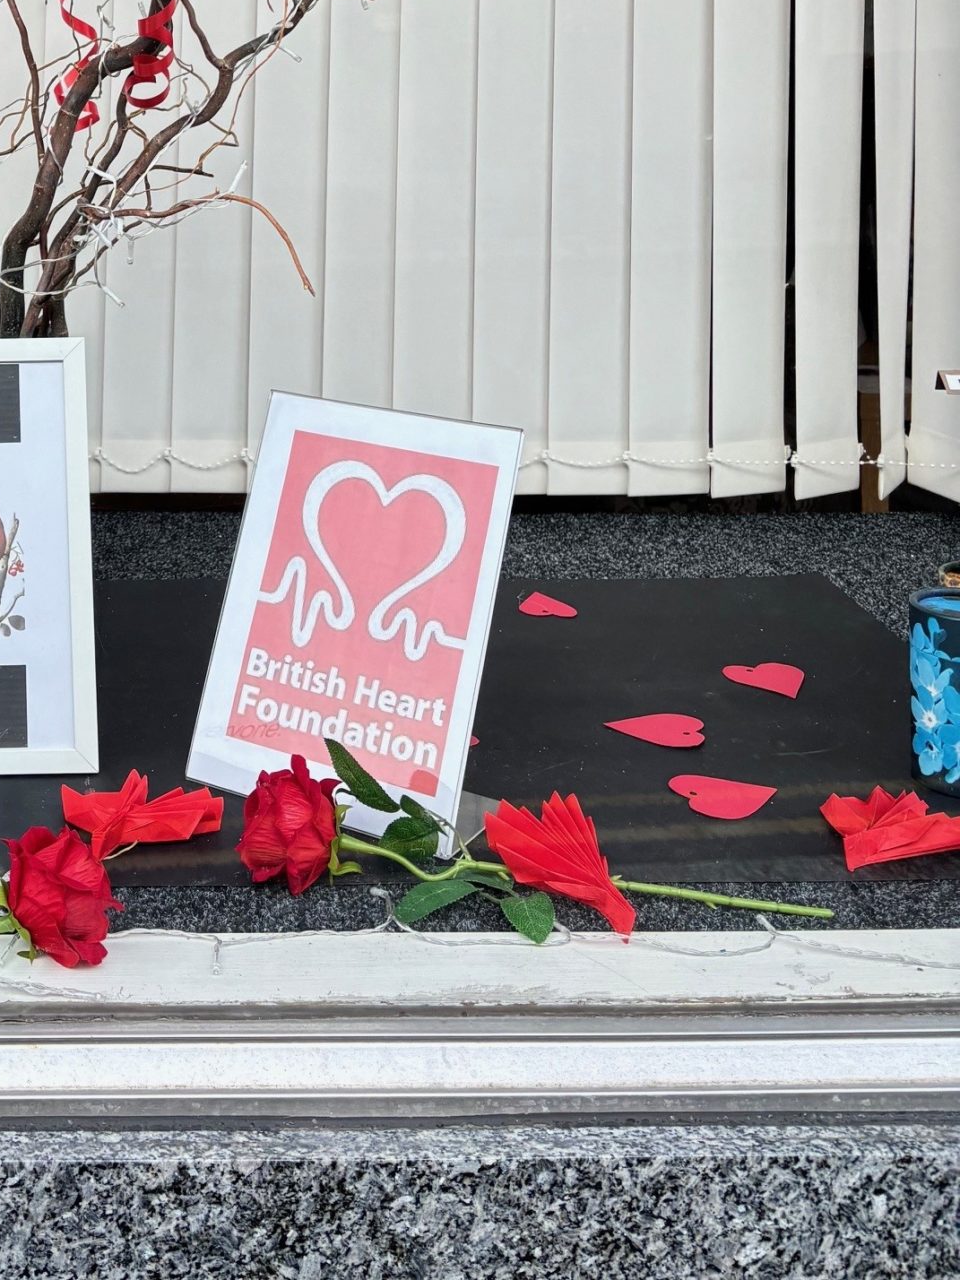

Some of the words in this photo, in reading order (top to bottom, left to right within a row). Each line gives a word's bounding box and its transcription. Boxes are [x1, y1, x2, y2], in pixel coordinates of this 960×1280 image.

[236, 684, 439, 769] Foundation
[246, 647, 346, 700] British
[353, 675, 447, 727] Heart
